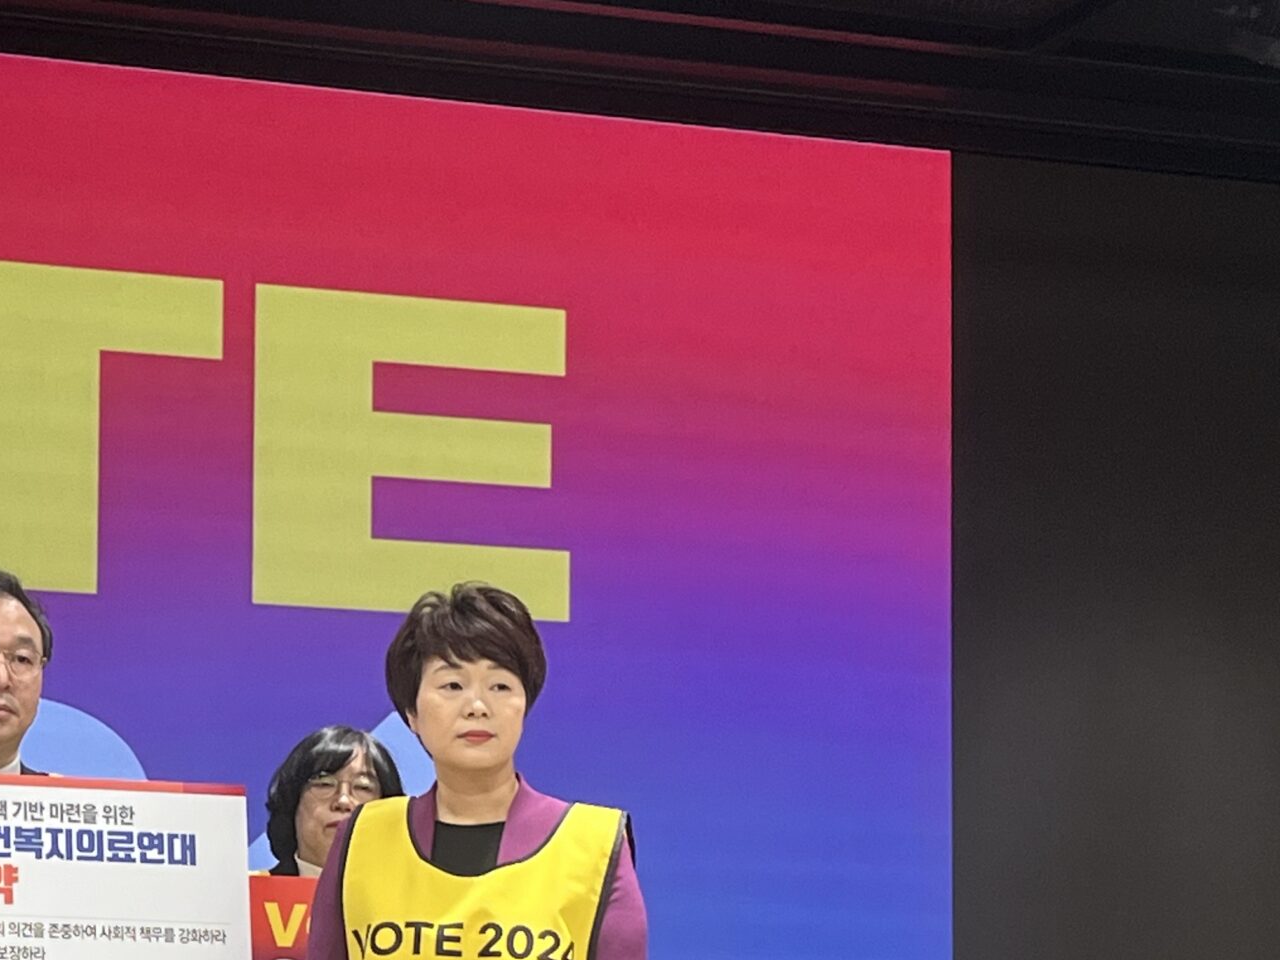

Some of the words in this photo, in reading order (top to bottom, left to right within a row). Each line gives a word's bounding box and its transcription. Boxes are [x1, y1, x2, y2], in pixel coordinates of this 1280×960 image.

[12, 802, 45, 822] 기반
[49, 803, 98, 825] 마련을
[102, 805, 135, 826] 위한
[8, 921, 45, 938] 의견을
[48, 922, 97, 940] 존중하여
[100, 924, 136, 941] 사회적
[178, 928, 227, 944] 강화하라
[352, 922, 464, 960] VOTE
